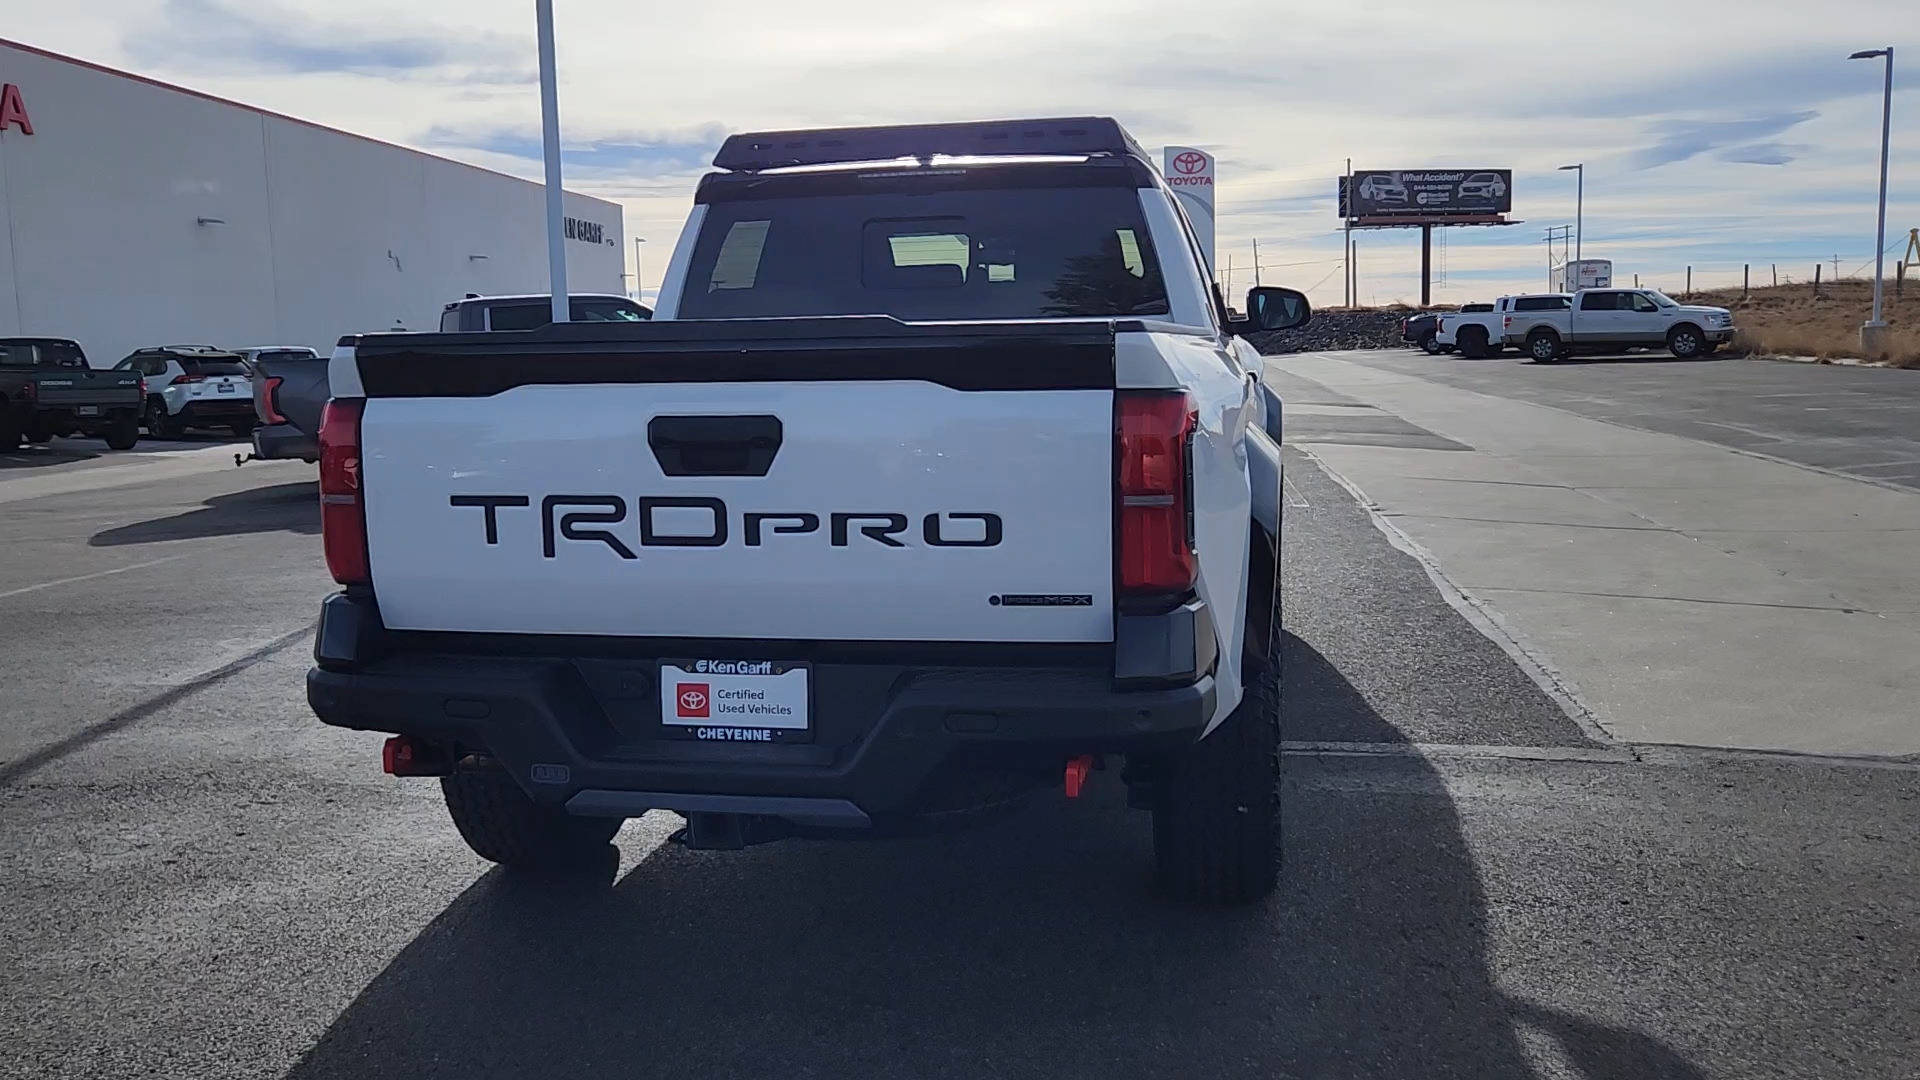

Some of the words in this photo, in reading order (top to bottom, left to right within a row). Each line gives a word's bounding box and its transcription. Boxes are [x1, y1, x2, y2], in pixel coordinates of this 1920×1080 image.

[1166, 176, 1213, 186] TOYOTA
[1402, 173, 1423, 182] What
[1425, 172, 1464, 182] Accident?
[450, 495, 728, 559] TRD
[743, 512, 1003, 547] PRO
[709, 660, 735, 673] Ken
[737, 661, 772, 674] Garff
[717, 689, 765, 700] Certified
[718, 704, 746, 713] Used
[748, 704, 792, 715] Vehicles
[697, 727, 772, 741] CHEYENNE
